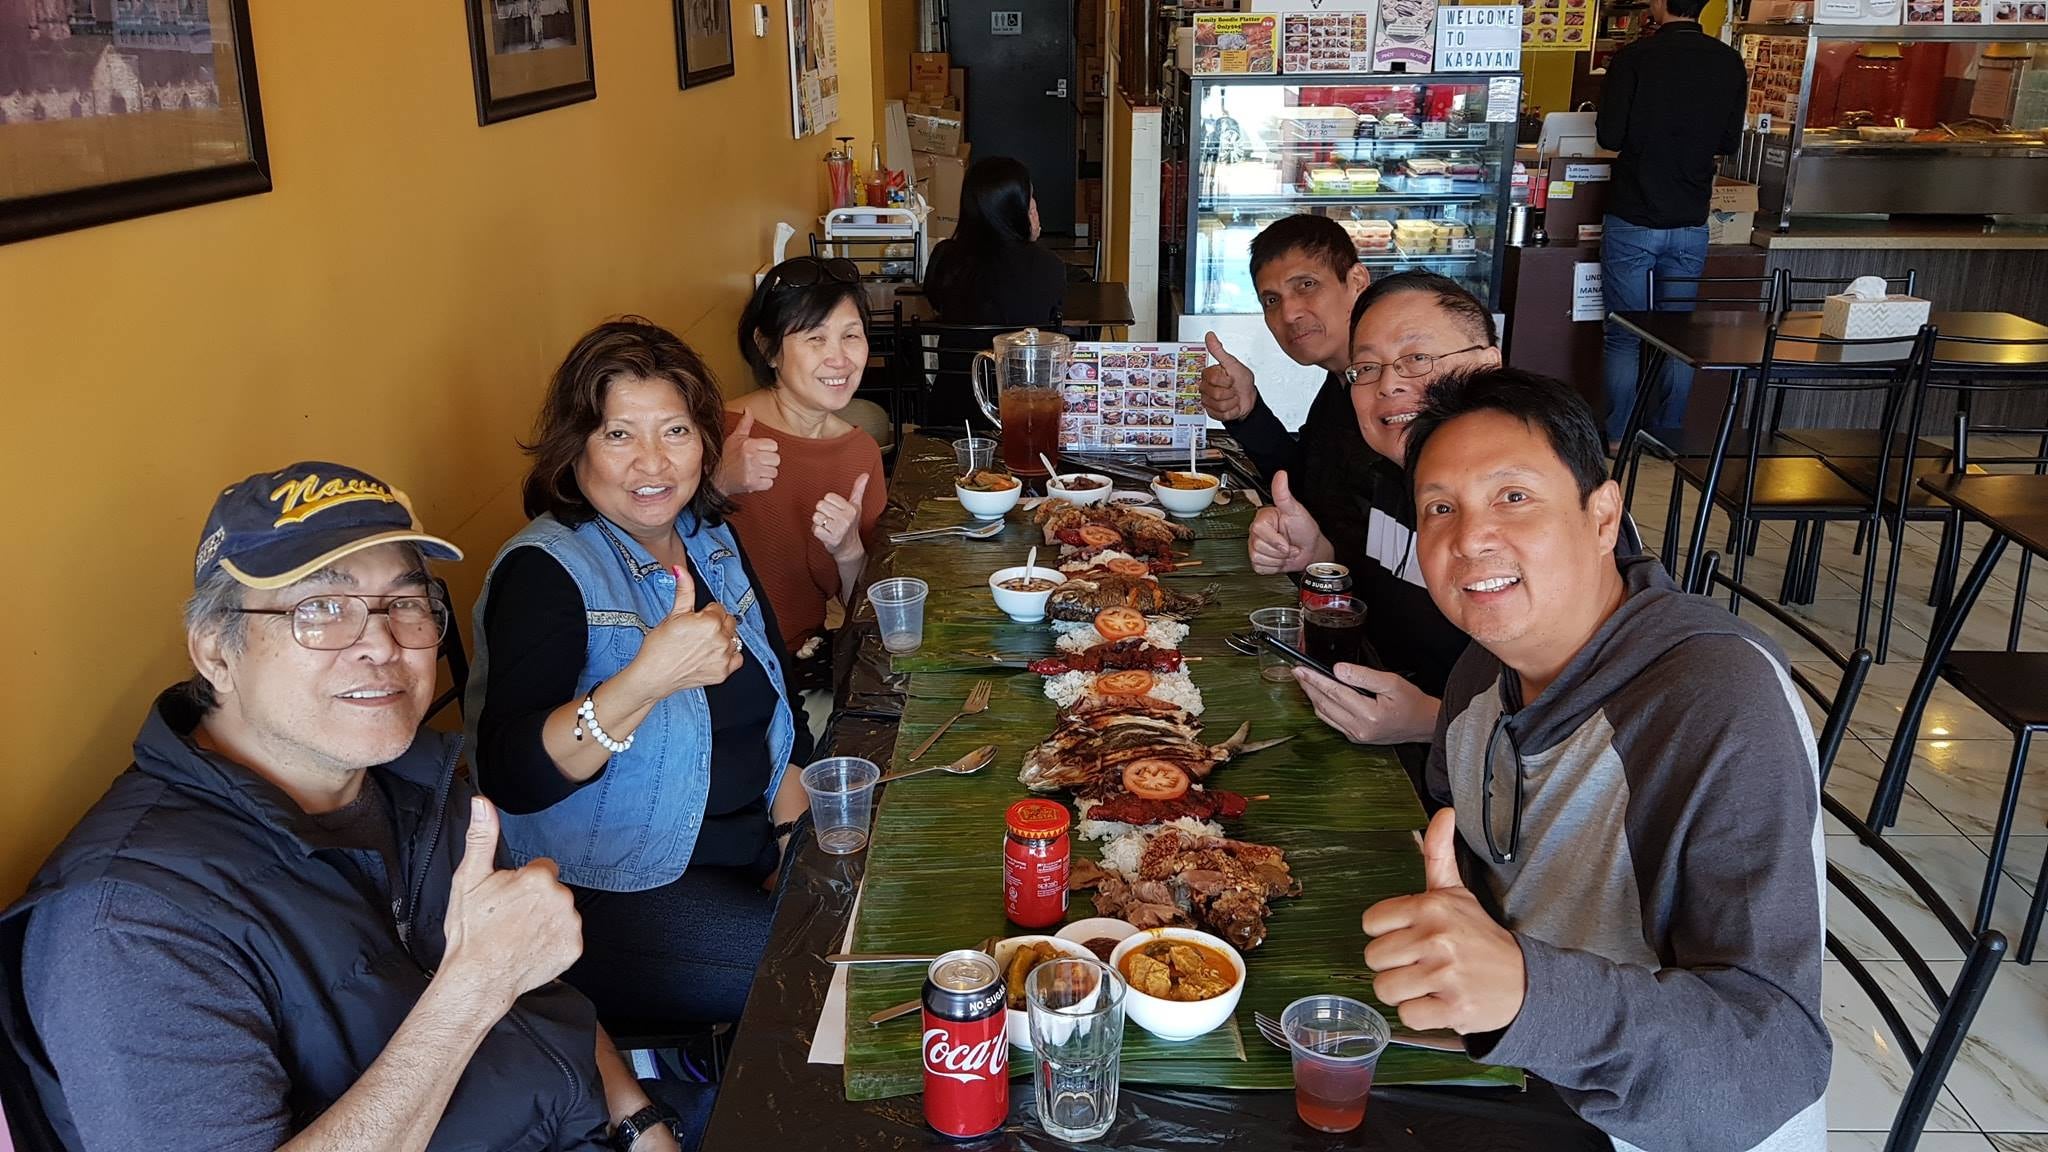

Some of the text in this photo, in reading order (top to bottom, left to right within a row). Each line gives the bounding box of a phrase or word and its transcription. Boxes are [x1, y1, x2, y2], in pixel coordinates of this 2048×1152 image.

[1447, 10, 1514, 25] WELCOME
[1447, 31, 1464, 46] TO
[1445, 52, 1513, 67] KABAYAN
[1761, 118, 1768, 128] 6
[1311, 581, 1333, 589] SUGAR
[969, 985, 1006, 1012] NO SUGAR
[923, 1022, 1009, 1083] Coca-C
